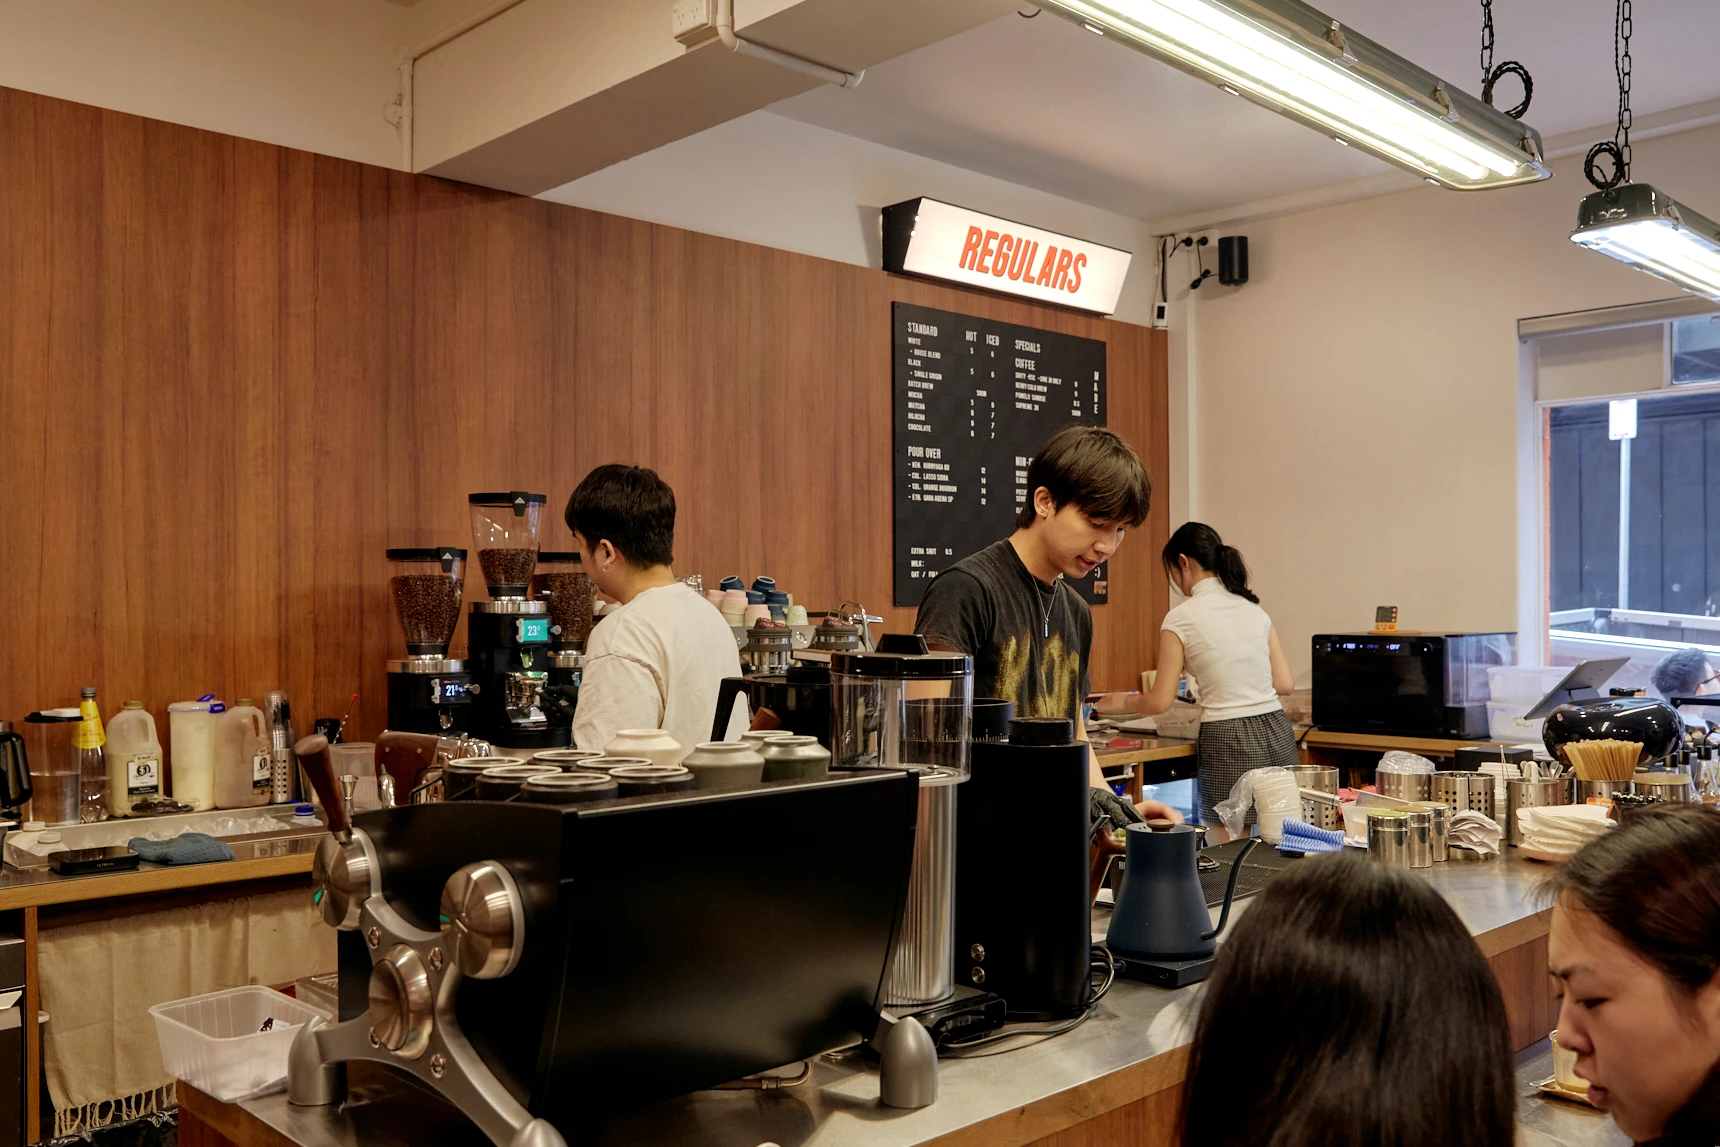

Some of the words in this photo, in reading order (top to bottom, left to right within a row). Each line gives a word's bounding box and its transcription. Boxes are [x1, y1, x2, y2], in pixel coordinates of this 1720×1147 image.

[959, 226, 1087, 293] REGULARS
[907, 322, 938, 337] STANDARD
[908, 337, 921, 345] WHITE
[966, 330, 977, 342] HOT
[986, 334, 1000, 346] ICED
[1015, 340, 1040, 353] SPECIALS
[914, 348, 927, 357] HOUSE
[928, 350, 941, 359] BLEND
[908, 358, 921, 367] BLACK
[1015, 358, 1035, 370] COFFEE
[914, 370, 928, 379] SINGLE
[908, 380, 921, 388] BATCH
[922, 382, 934, 390] BREW
[908, 391, 922, 399] MOCHA
[908, 402, 925, 410] MATCHA
[908, 423, 931, 432] CHOCOLATE
[908, 446, 924, 458] POUR
[925, 448, 941, 459] OVER
[911, 547, 924, 555] EXTRA
